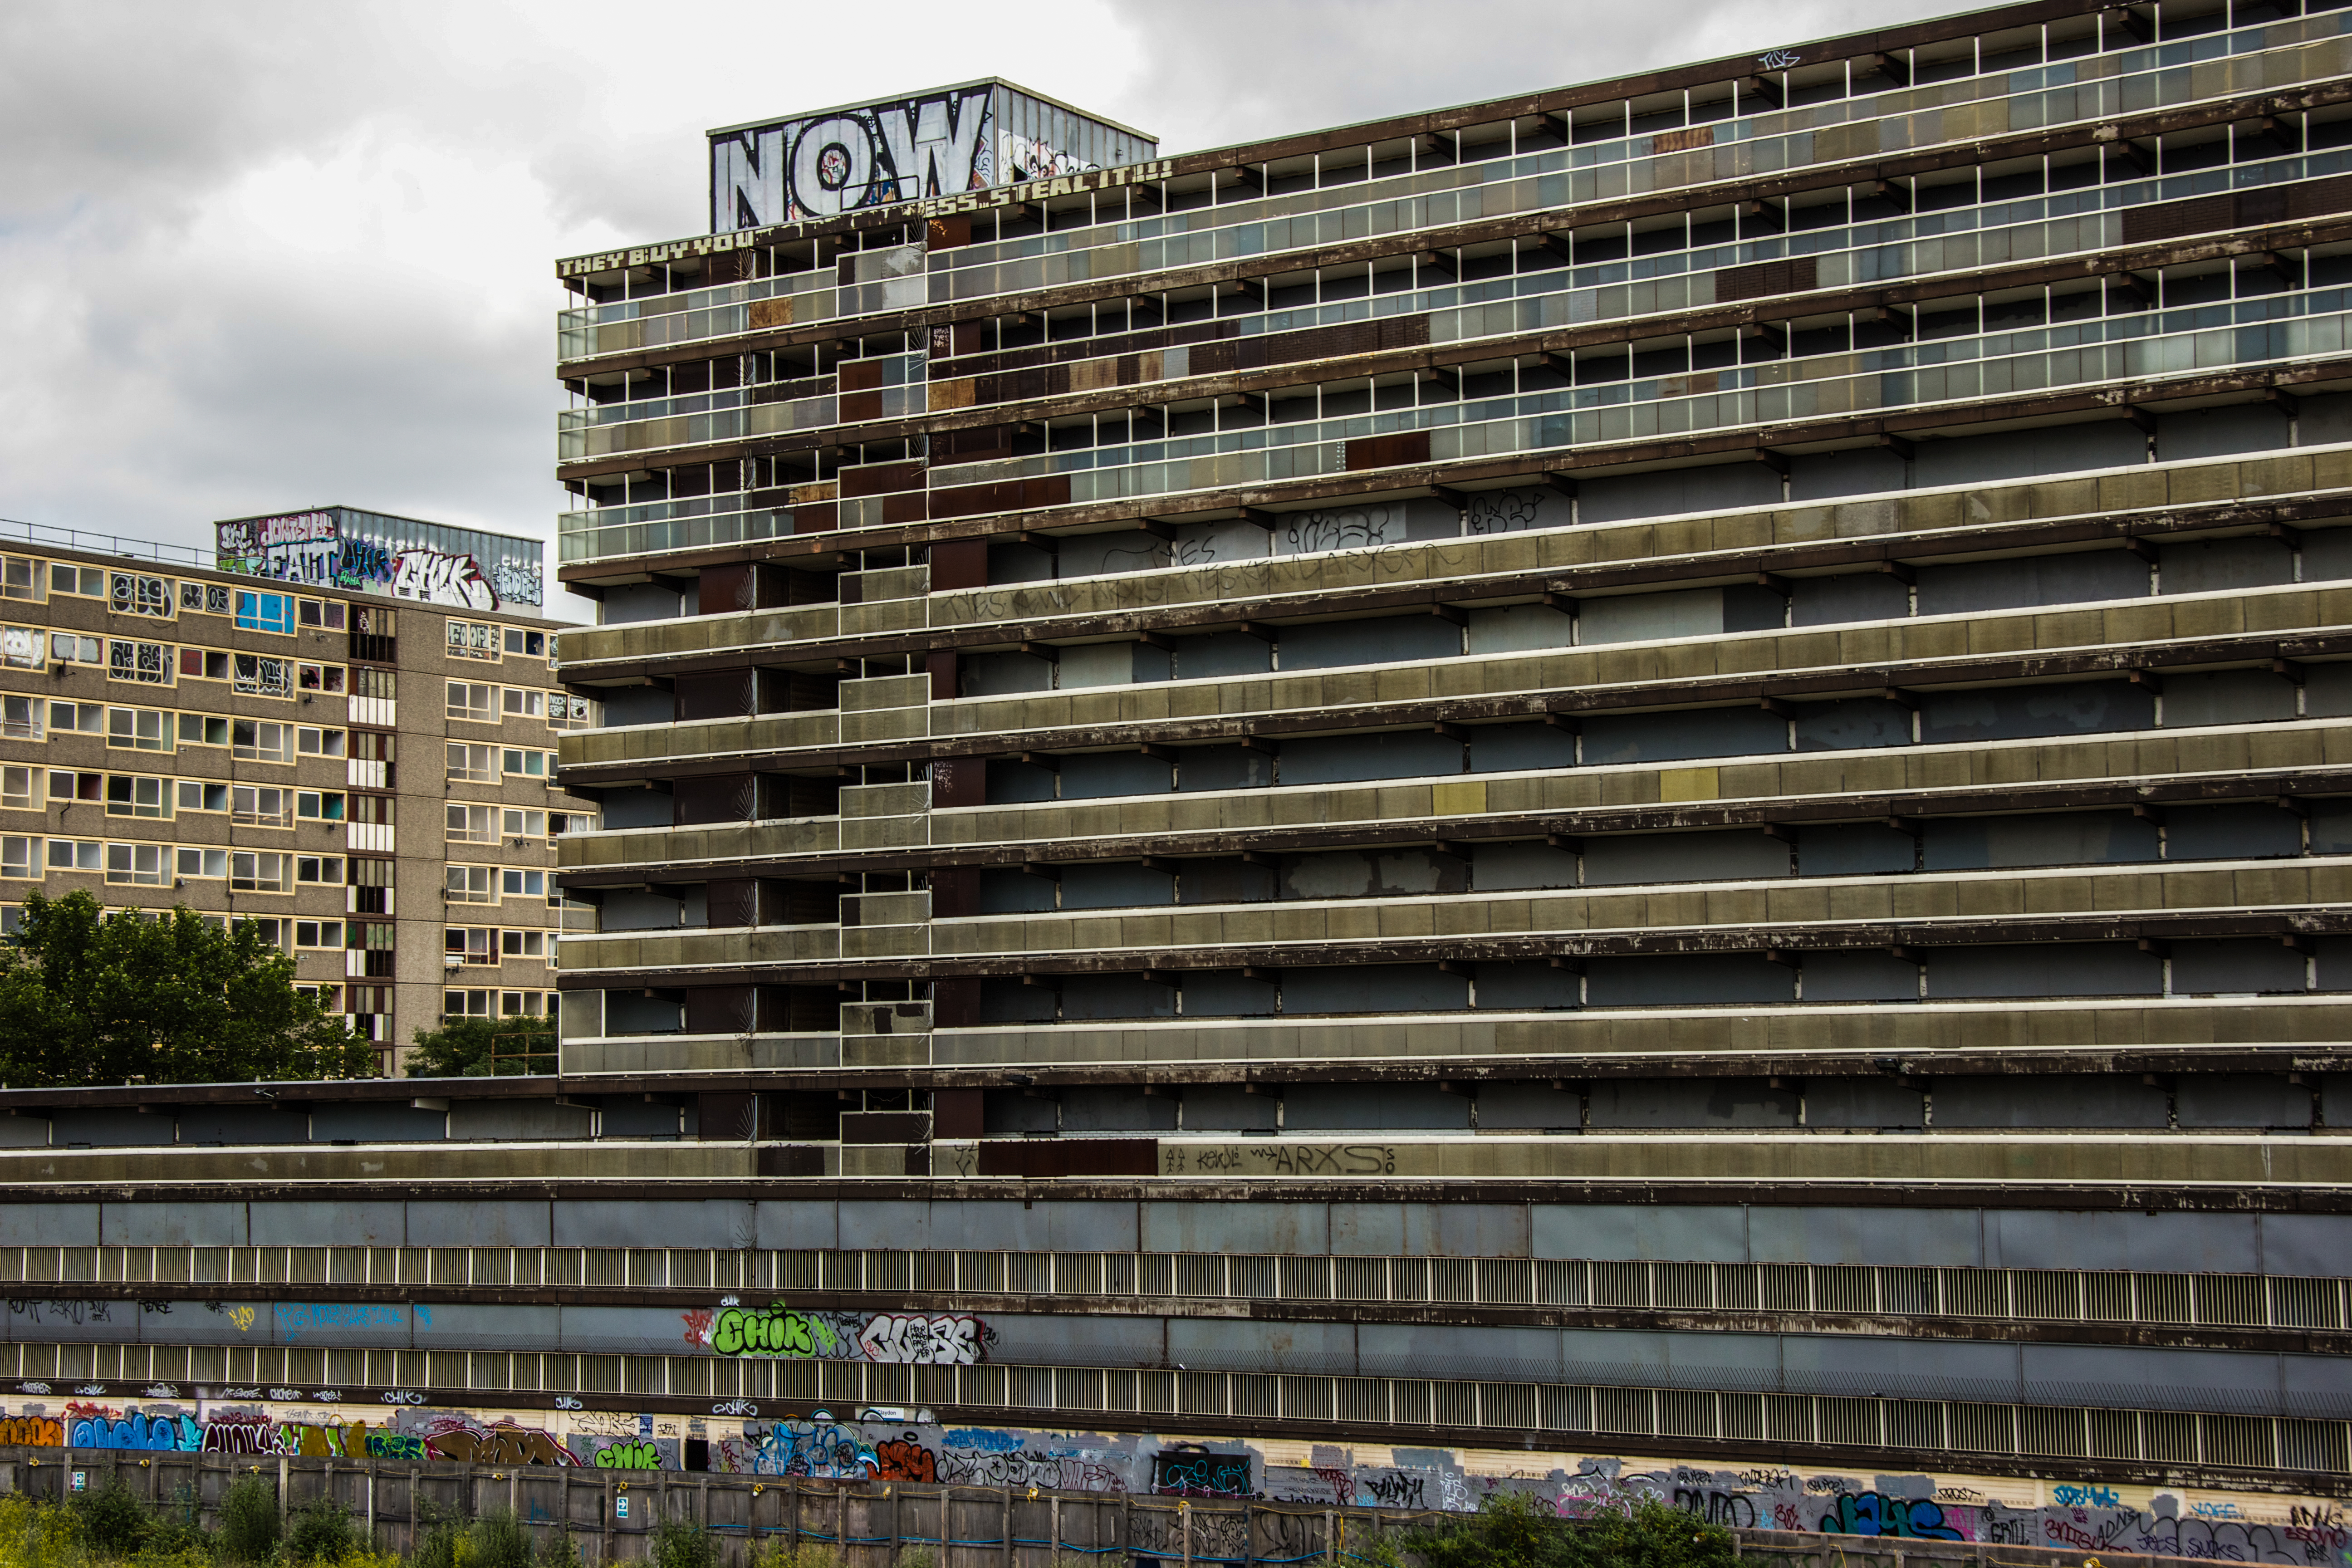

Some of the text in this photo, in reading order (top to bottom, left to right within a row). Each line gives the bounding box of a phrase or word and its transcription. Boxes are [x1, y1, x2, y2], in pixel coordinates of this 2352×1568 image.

[710, 85, 994, 234] NOW
[560, 252, 624, 276] THEY
[629, 242, 688, 266] BUY
[693, 228, 773, 255] YOU
[990, 171, 1090, 206] STEAL
[340, 570, 362, 587] HAHA
